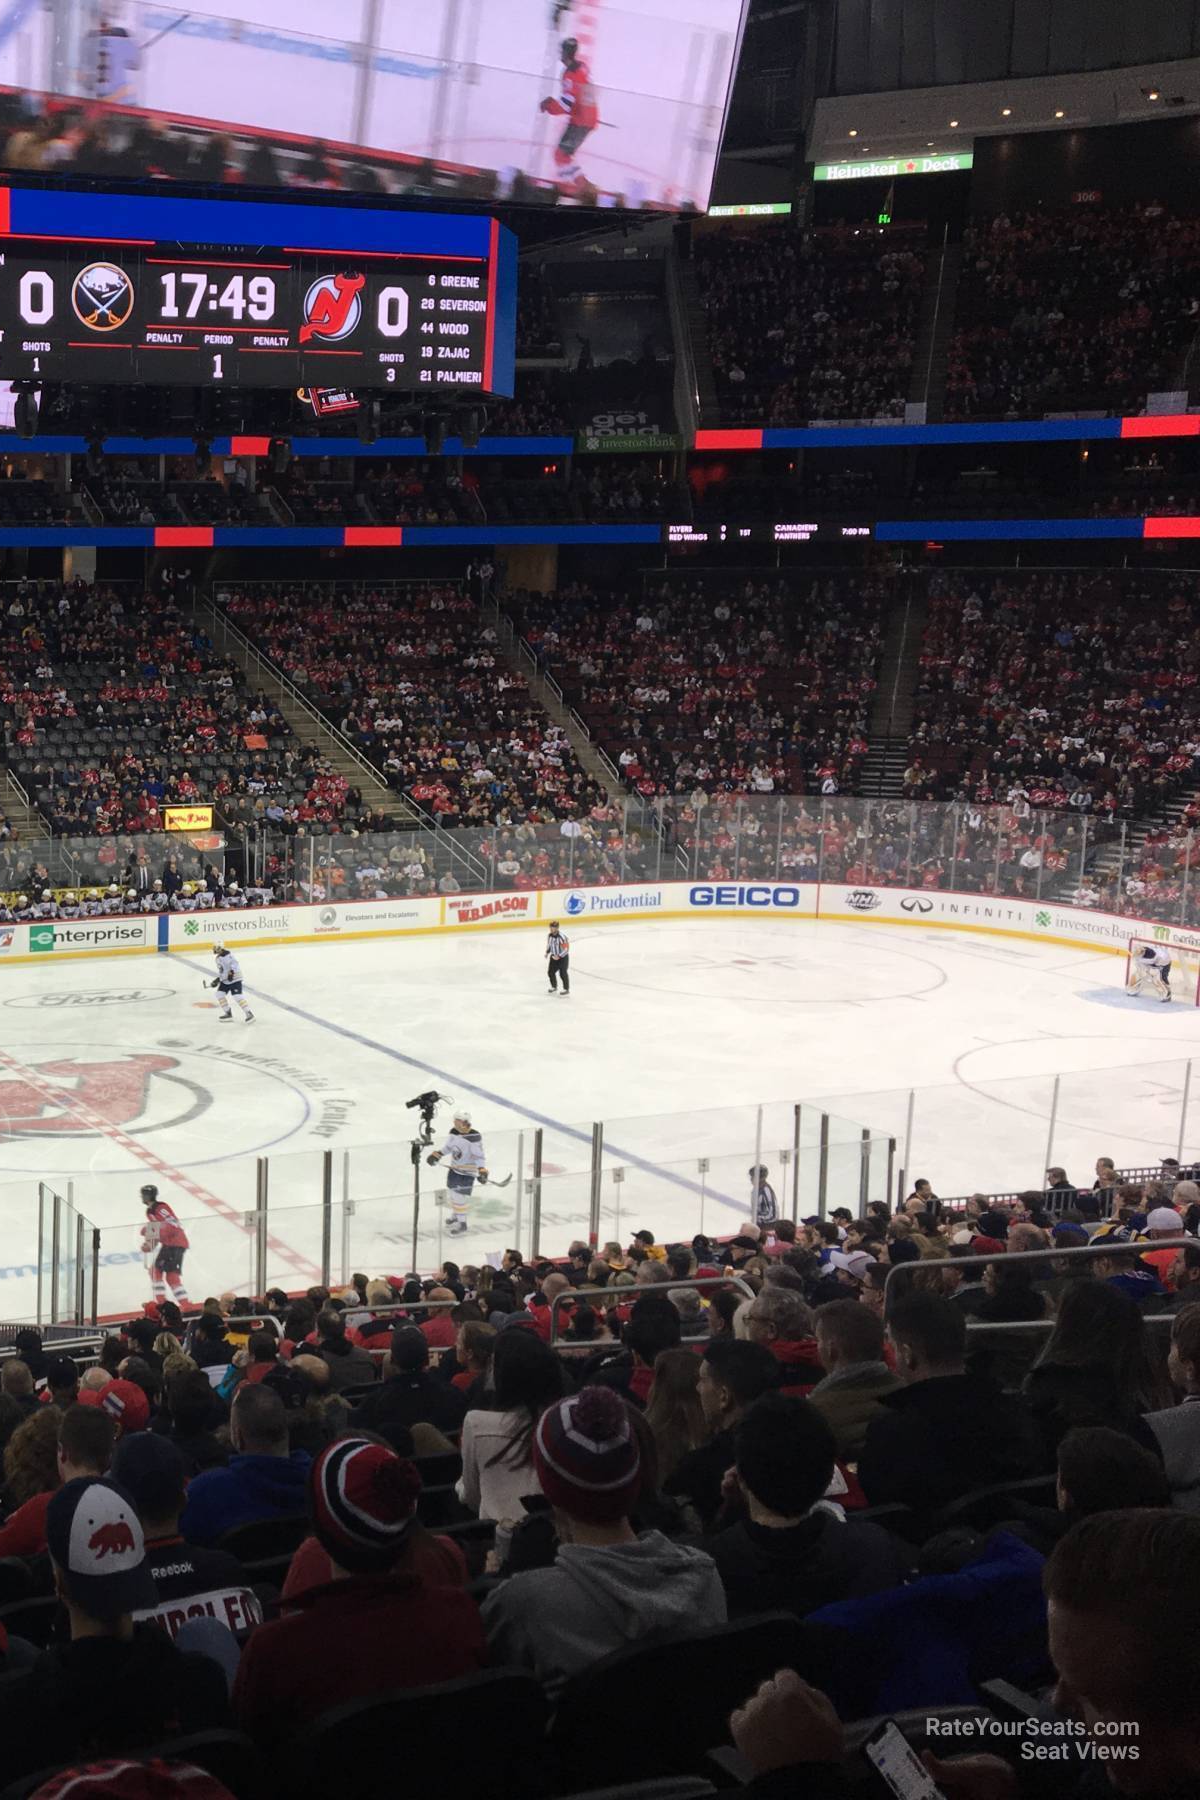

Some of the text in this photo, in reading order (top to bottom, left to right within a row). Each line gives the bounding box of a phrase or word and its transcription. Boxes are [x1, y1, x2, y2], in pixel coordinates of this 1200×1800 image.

[827, 158, 960, 180] Heineken Deck
[750, 204, 774, 214] Deck
[428, 275, 480, 289] 6 GREENE
[20, 270, 54, 324] 0
[160, 272, 276, 321] 17:49
[377, 286, 409, 337] 0
[421, 298, 486, 313] 28 SEVERSON
[421, 322, 469, 336] 44 WOOD
[146, 332, 183, 344] PENALTY
[204, 334, 234, 345] PERIOD
[253, 336, 289, 347] PENALTY
[22, 341, 51, 352] SHOTS
[421, 346, 470, 360] 19 ZAJAC
[33, 357, 40, 372] 1
[378, 352, 404, 363] SHOTS
[212, 354, 223, 378] 1
[386, 369, 396, 382] 3
[420, 370, 482, 384] 21 PALMIERI
[592, 411, 648, 428] get
[587, 424, 660, 437] loud
[602, 436, 676, 449] investorsBank
[774, 524, 818, 532] CANADIENS
[842, 528, 858, 536] 7:00
[774, 532, 810, 540] PANTHERS
[591, 891, 662, 910] Prudential
[690, 886, 800, 907] GEICO
[346, 913, 374, 922] Elevators
[388, 911, 419, 919] Escalators
[941, 902, 1022, 921] INFINITI
[203, 915, 289, 934] investorsBank
[31, 925, 144, 945] enterprise
[38, 990, 148, 1007] Ford
[196, 1044, 356, 1138] Prudential Center
[151, 1561, 194, 1580] Reebok
